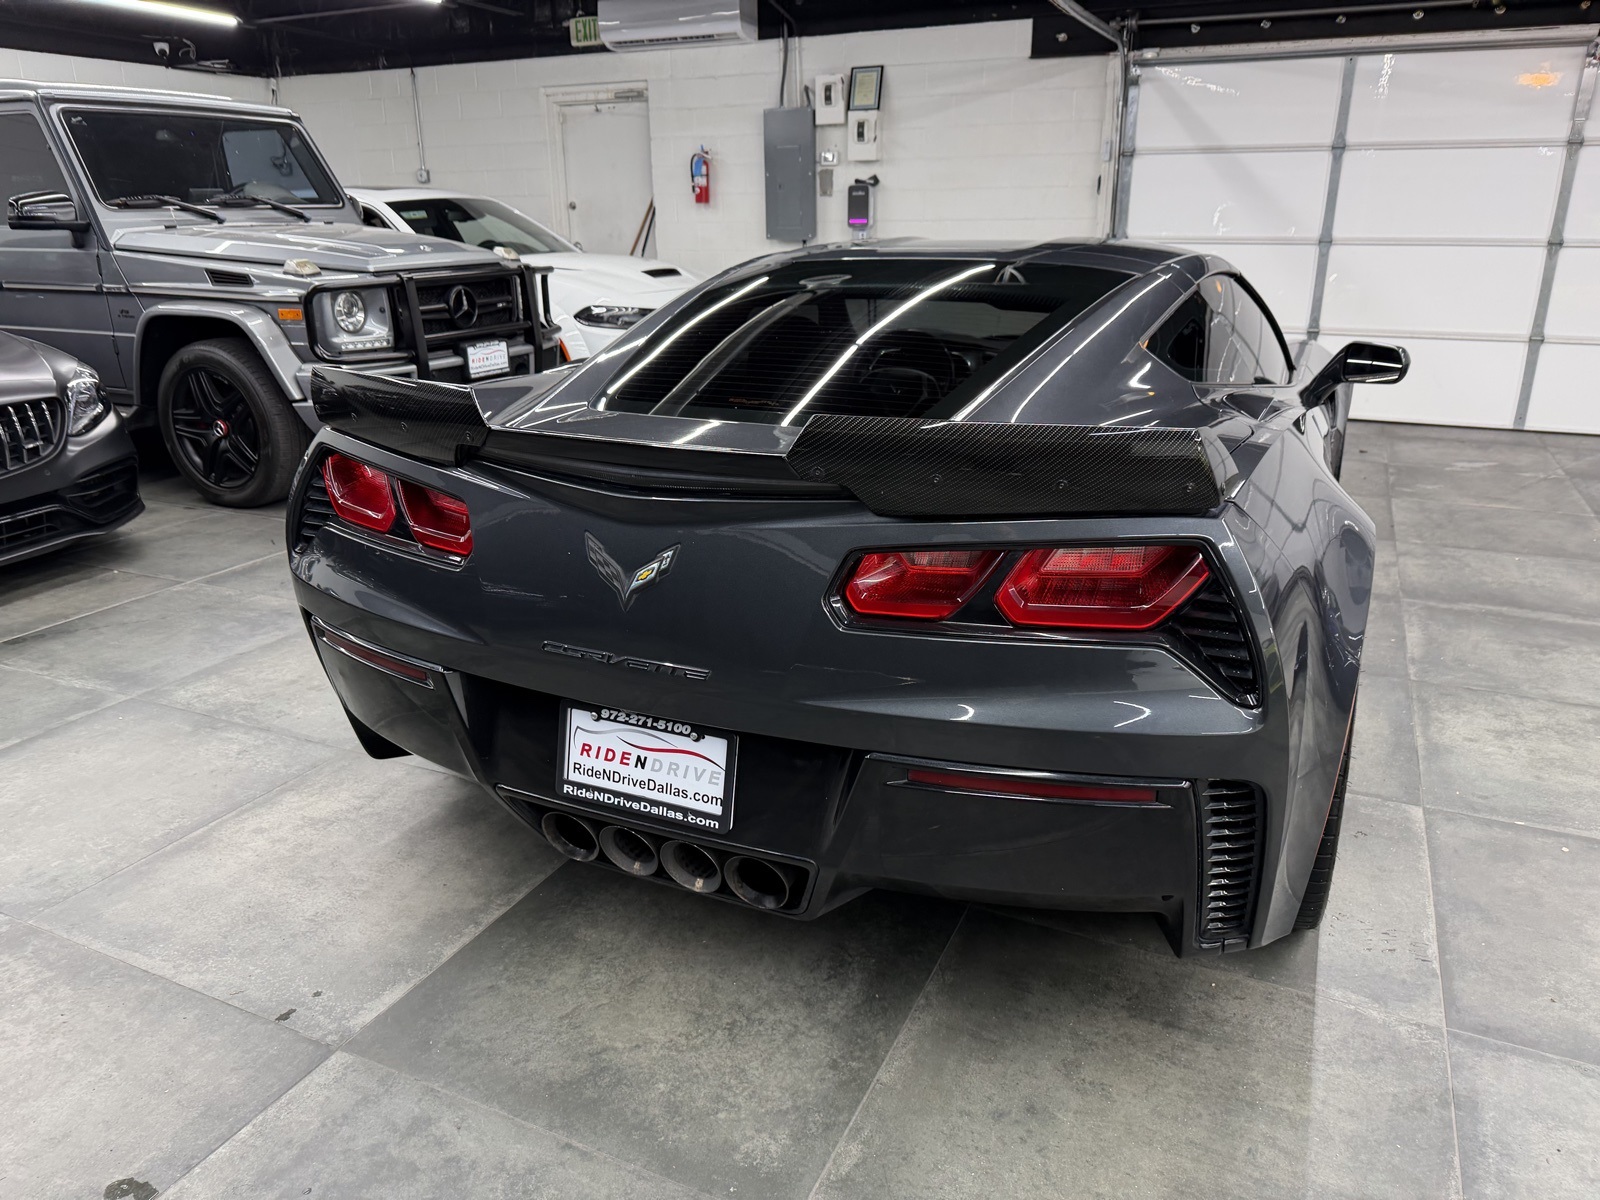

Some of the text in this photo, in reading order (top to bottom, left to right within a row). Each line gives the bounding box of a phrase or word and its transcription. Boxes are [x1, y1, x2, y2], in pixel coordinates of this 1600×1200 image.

[575, 18, 598, 43] EXIT
[541, 640, 712, 681] CORVETTE
[600, 708, 692, 735] 972-271-5100
[573, 762, 723, 807] RideNDriveDallas.com
[563, 784, 719, 829] RideNDriveDallas.com
